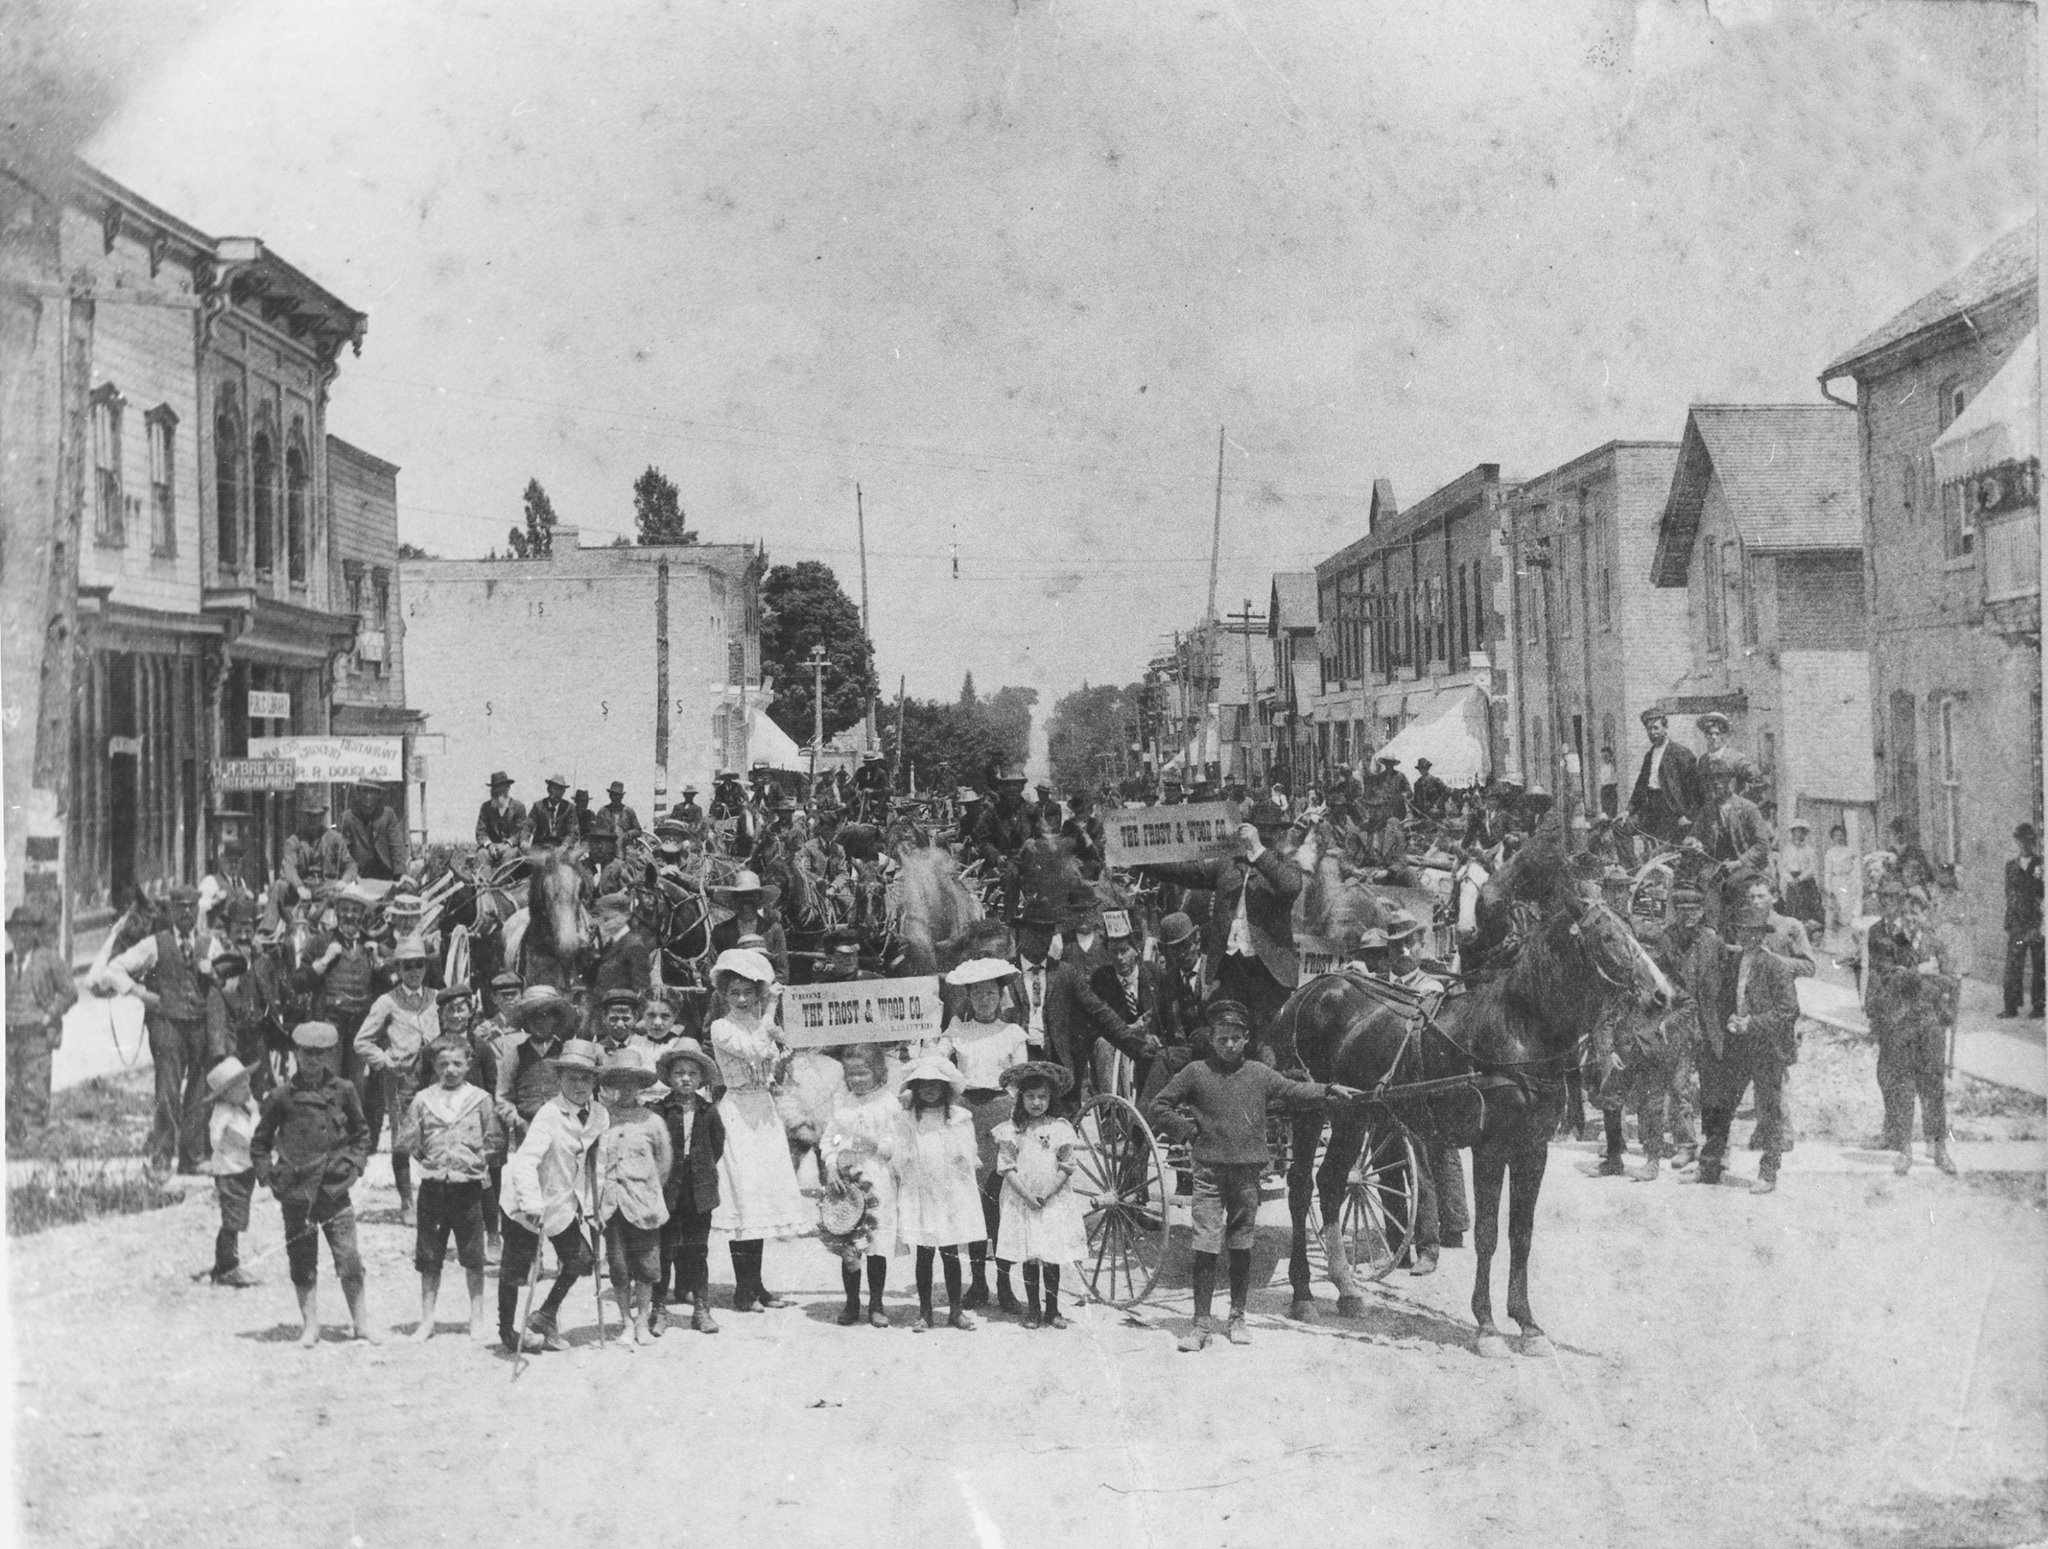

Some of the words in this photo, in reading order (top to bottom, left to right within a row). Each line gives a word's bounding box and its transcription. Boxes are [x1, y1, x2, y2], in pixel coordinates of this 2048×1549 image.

[240, 761, 293, 776] BREWER
[214, 776, 294, 790] PHOTOGRAPHER
[1120, 825, 1139, 847] THE
[1143, 822, 1171, 846] FROST
[1176, 822, 1184, 843] &
[1186, 820, 1212, 843] WOOD
[1304, 953, 1333, 974] FROST
[791, 992, 821, 1001] FROM
[802, 1002, 824, 1027] THE
[828, 1000, 859, 1026] FROST
[865, 999, 873, 1023] &
[877, 997, 905, 1021] WOOD
[909, 996, 924, 1020] CO.
[890, 1022, 934, 1033] LIMITED
